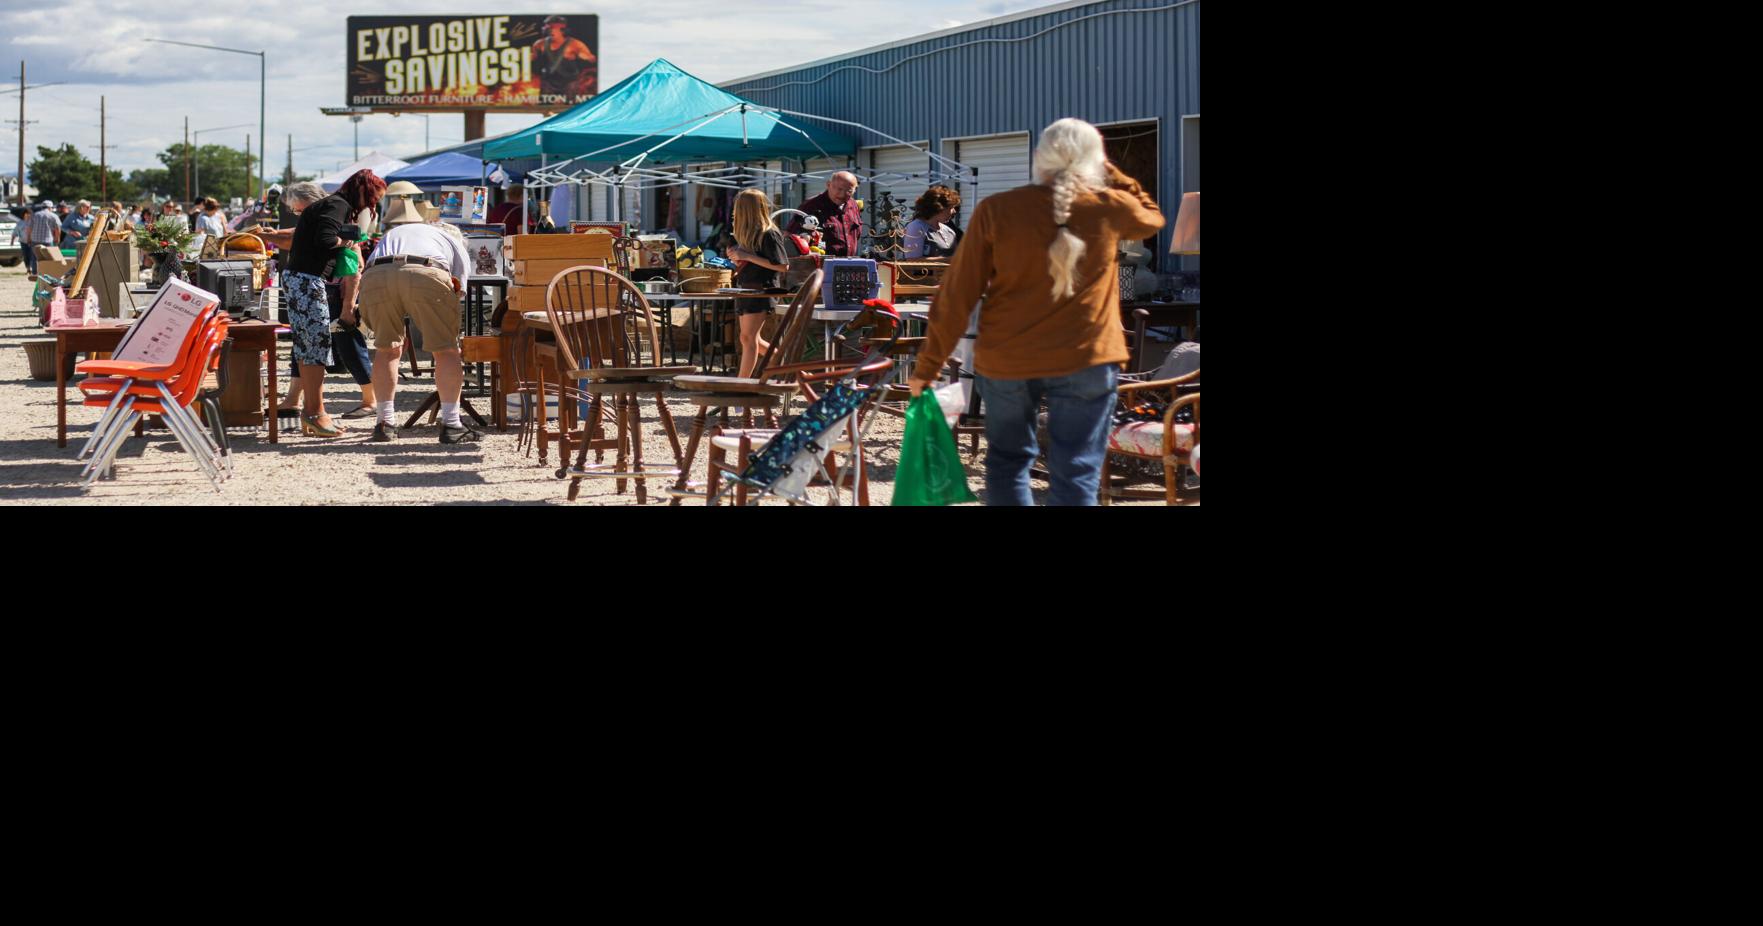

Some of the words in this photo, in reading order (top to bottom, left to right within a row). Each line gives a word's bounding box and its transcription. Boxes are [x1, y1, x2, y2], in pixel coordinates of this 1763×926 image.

[357, 16, 510, 61] EXPLOSIVE
[385, 46, 532, 95] SAVINGS!
[353, 95, 427, 104] BITTERROOT
[430, 94, 494, 104] FURNITURE
[190, 298, 202, 307] LG
